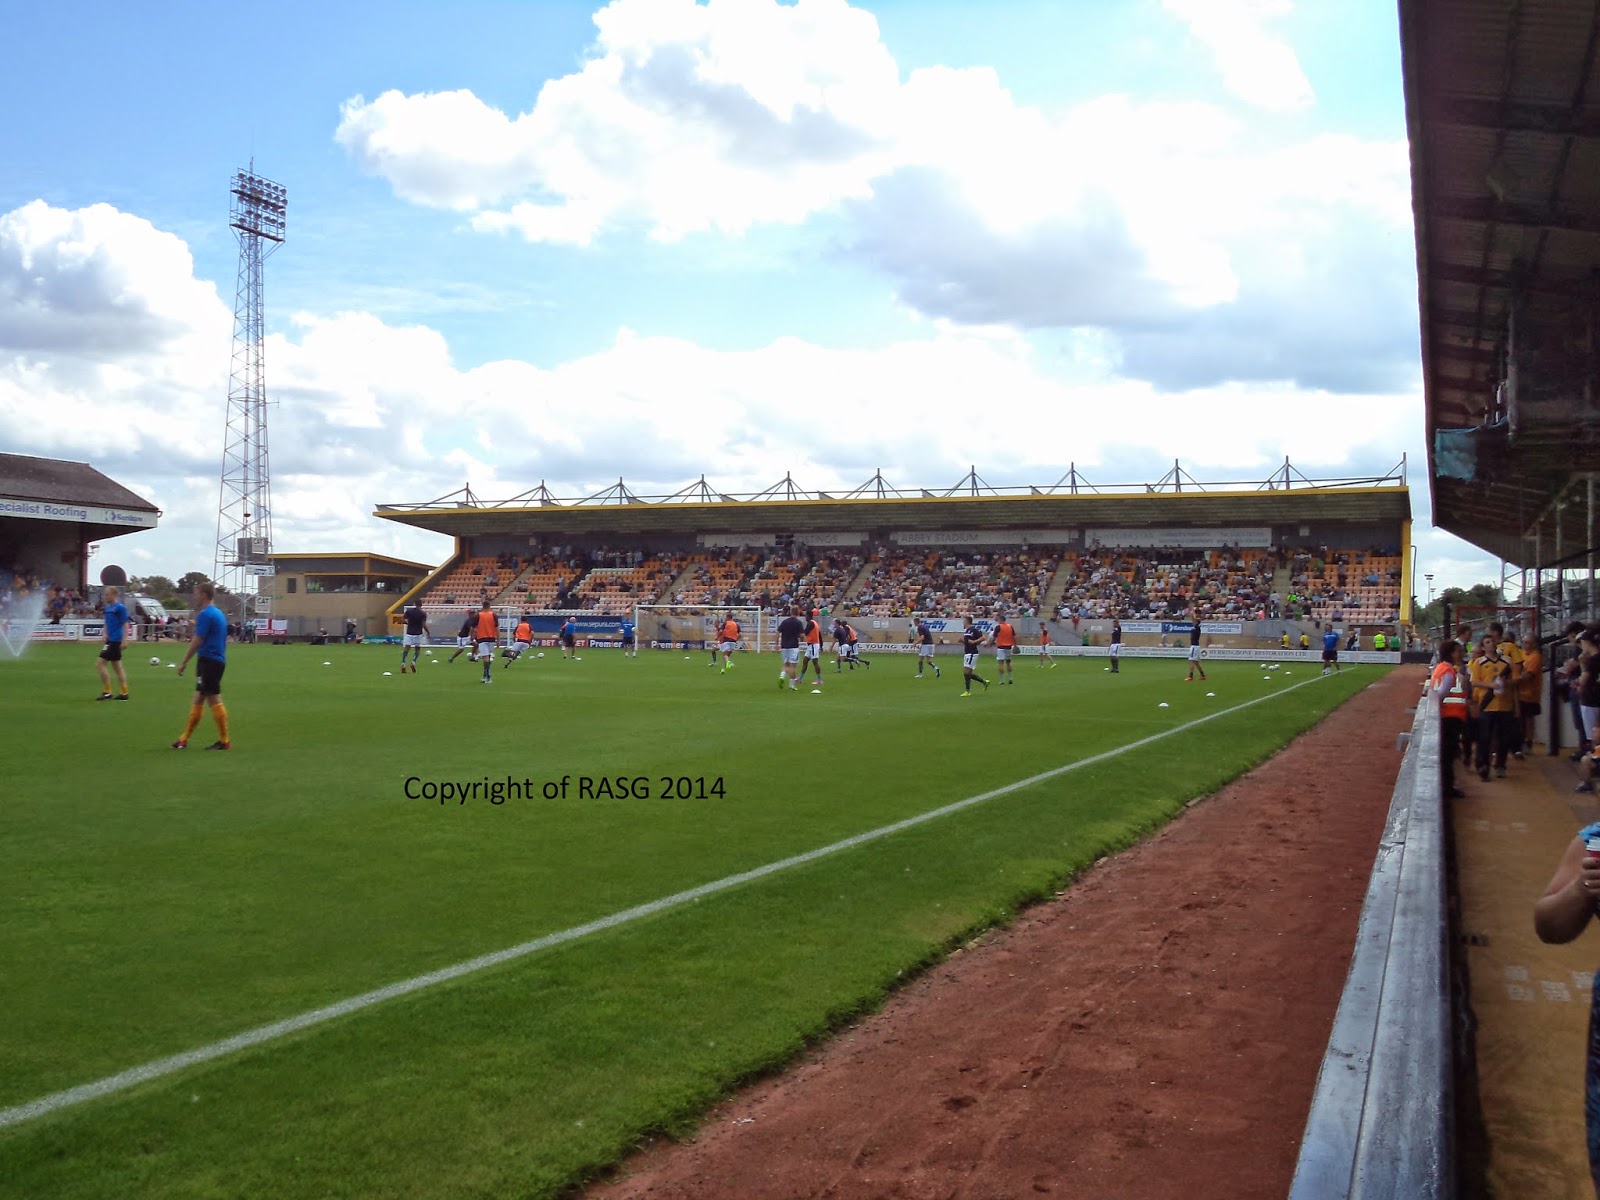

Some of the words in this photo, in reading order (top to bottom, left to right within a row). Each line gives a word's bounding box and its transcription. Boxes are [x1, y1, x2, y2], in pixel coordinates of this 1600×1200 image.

[43, 505, 87, 520] Roofing
[902, 533, 931, 543] ABBEY
[935, 532, 979, 543] STADIUM
[257, 597, 270, 605] CAT
[574, 621, 621, 629] www.sepura.com
[541, 639, 556, 647] BET
[589, 639, 623, 649] Premier
[651, 640, 685, 650] Premier
